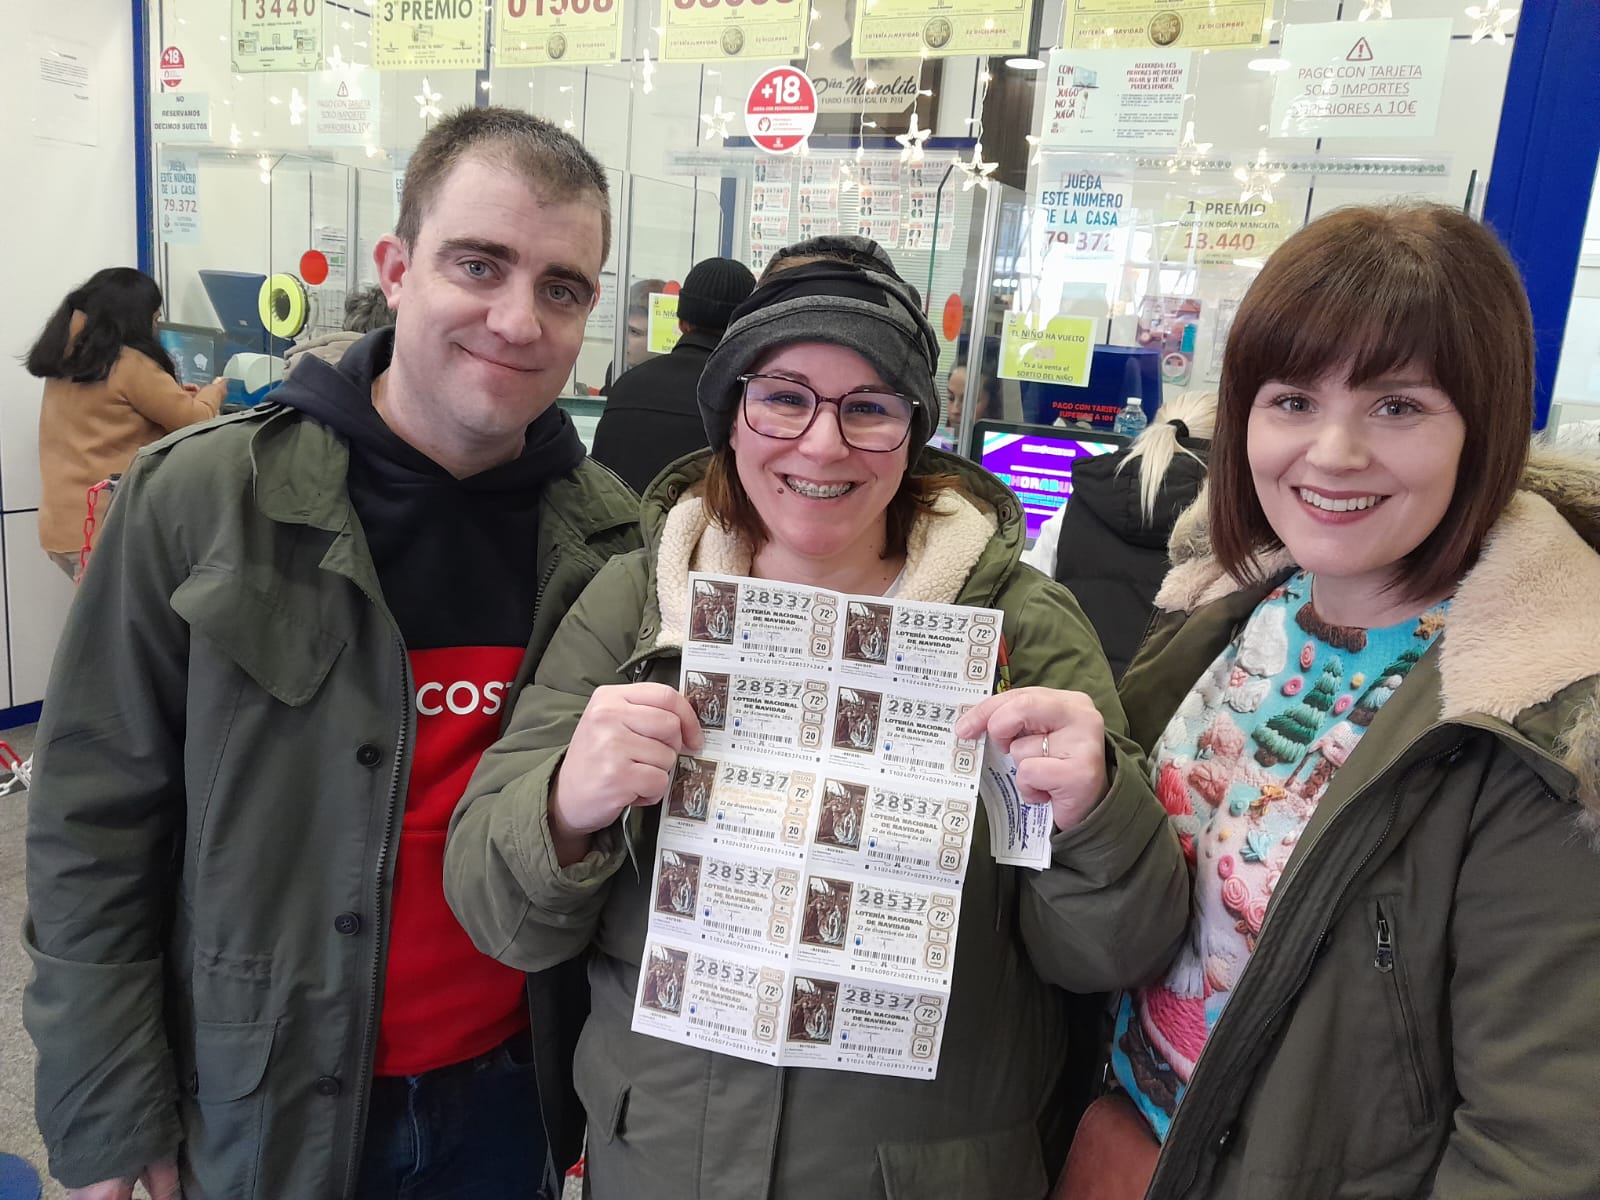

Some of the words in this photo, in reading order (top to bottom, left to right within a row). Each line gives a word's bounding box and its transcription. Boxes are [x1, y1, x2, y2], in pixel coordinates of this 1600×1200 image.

[401, 0, 473, 21] PREMIO
[1337, 66, 1366, 78] CON
[1369, 65, 1423, 78] TARJETA
[761, 75, 801, 104] +18
[1342, 82, 1410, 95] IMPORTES
[1373, 103, 1383, 114] A
[1388, 100, 1418, 114] 10€
[1064, 173, 1103, 190] JUEGA
[163, 198, 198, 213] 79.372
[1041, 191, 1070, 206] ESTE
[1205, 202, 1267, 216] PREMIO
[1063, 209, 1078, 225] LA
[1085, 210, 1119, 226] CASA
[1183, 232, 1256, 251] 13.440
[1021, 329, 1044, 339] NIÑO
[1058, 334, 1085, 343] VUELTO
[1052, 401, 1074, 410] PAGO
[744, 590, 811, 609] 28537
[899, 612, 969, 631] 28537
[919, 639, 951, 648] NAVIDAD
[928, 634, 965, 643] NACIONAL
[816, 643, 826, 651] 20
[737, 679, 802, 697] 28537
[888, 700, 956, 720] 28537
[805, 731, 816, 740] 20
[959, 758, 970, 766] 20
[724, 767, 788, 789] 28537
[874, 793, 942, 816] 28537
[789, 826, 799, 835] 20
[945, 855, 955, 865] 20
[708, 863, 773, 886] 28537
[859, 889, 927, 912] 28537
[775, 925, 784, 934] 20
[931, 952, 941, 961] 20
[695, 959, 758, 985] 28537
[845, 989, 914, 1009] 28537
[760, 1024, 770, 1033] 20
[917, 1044, 928, 1052] 20
